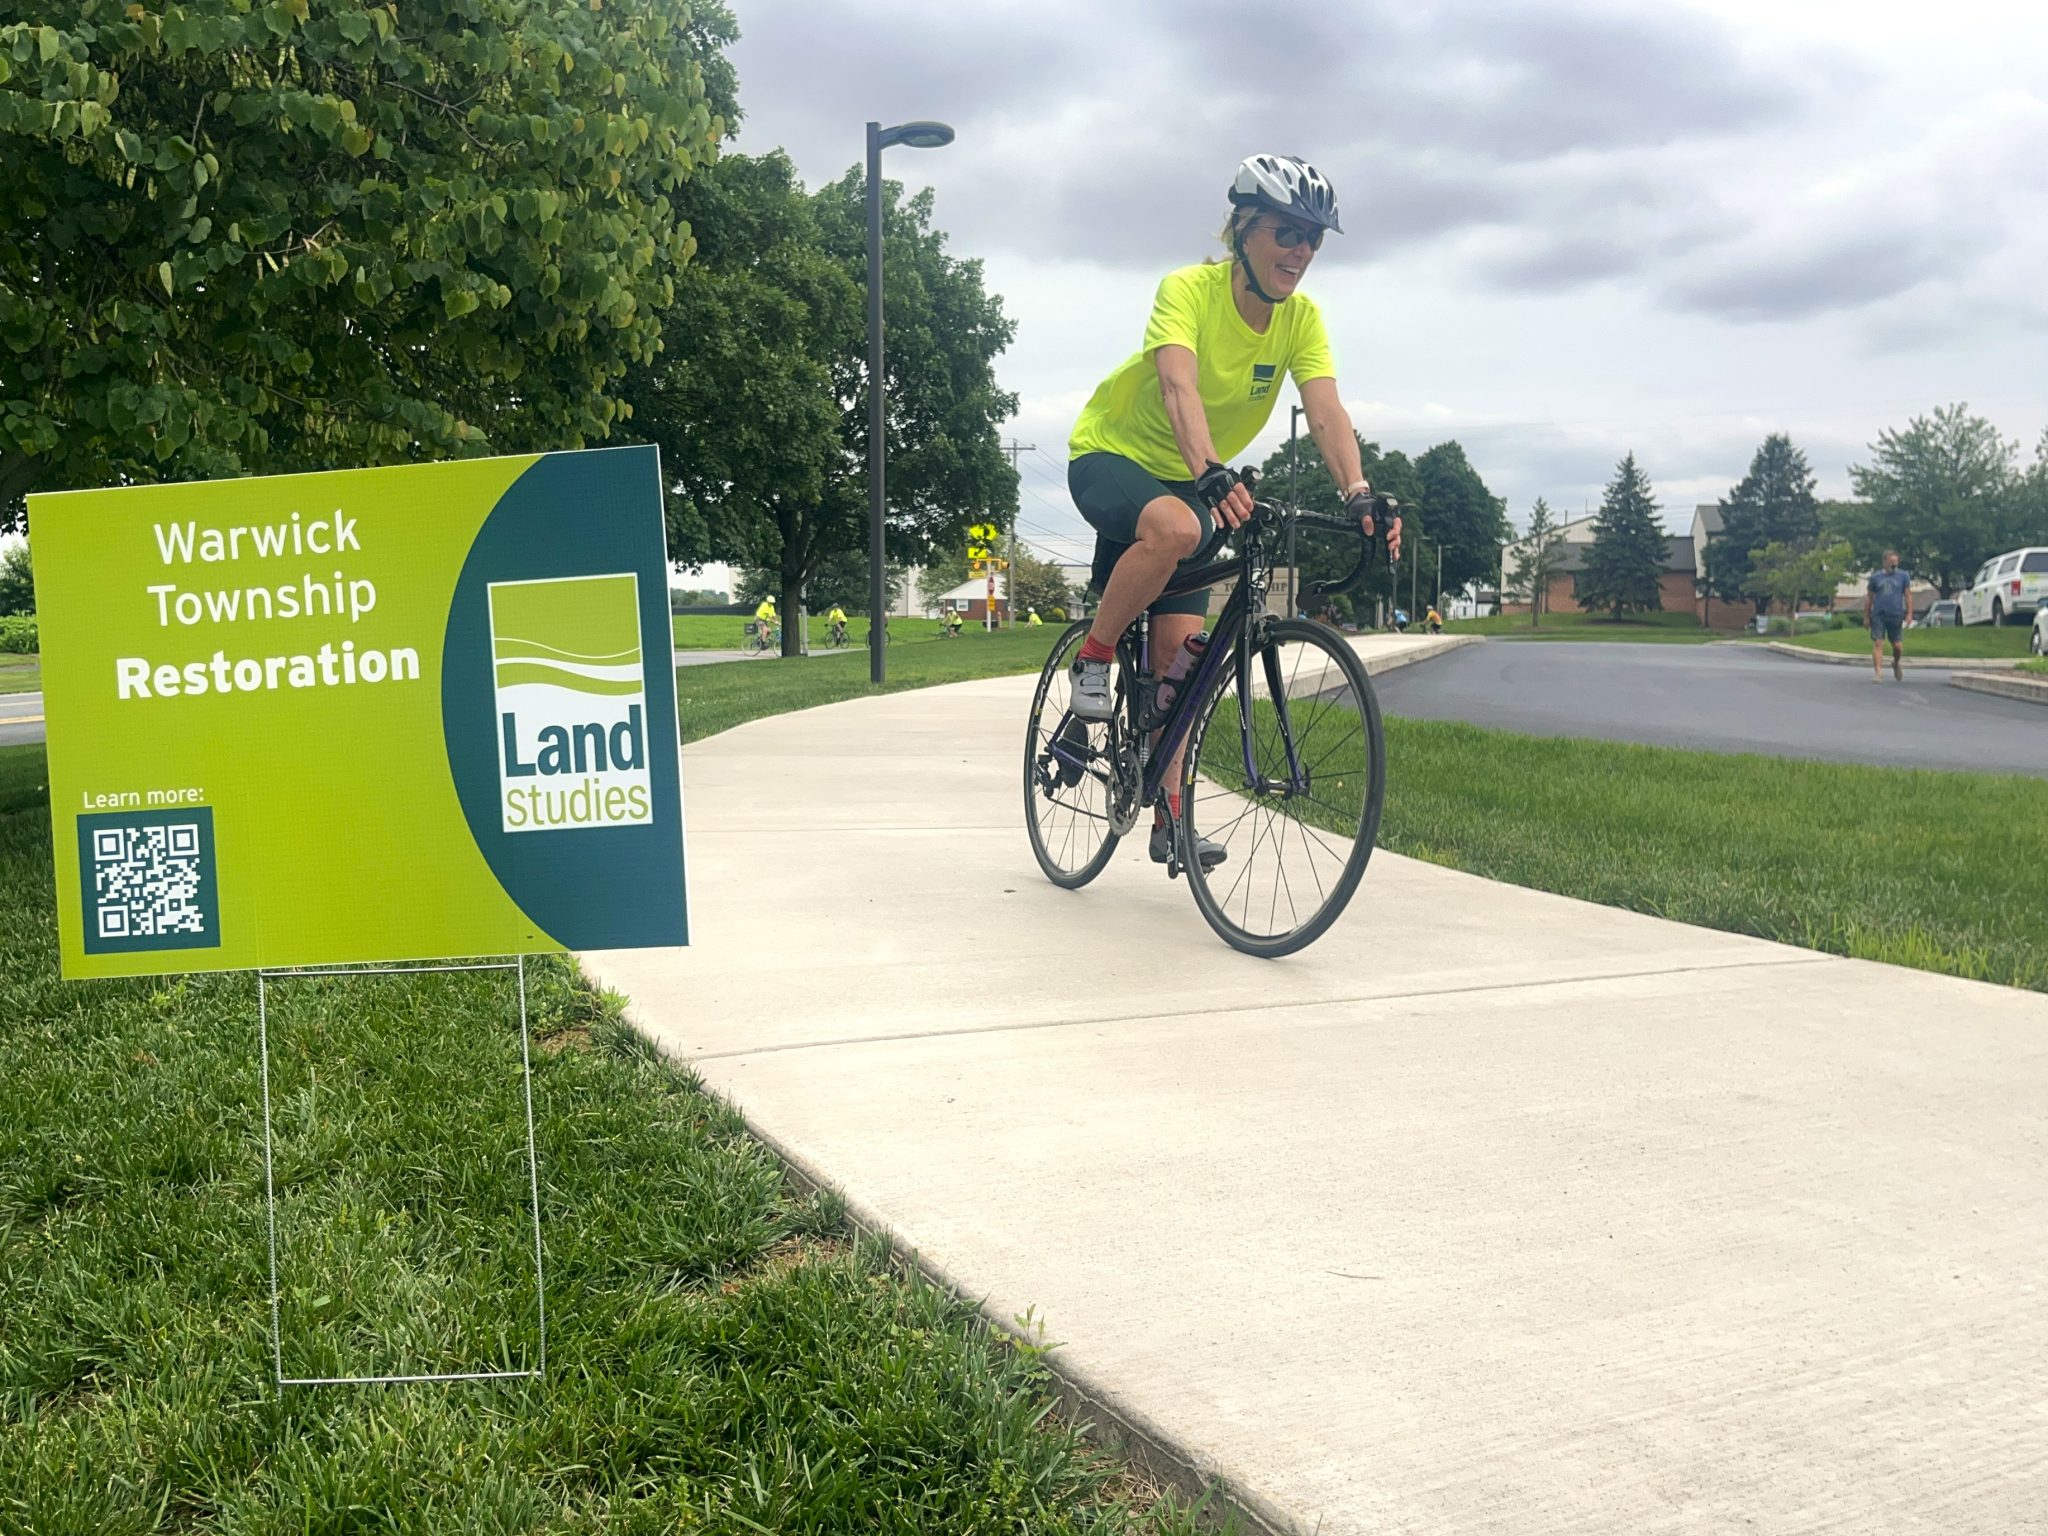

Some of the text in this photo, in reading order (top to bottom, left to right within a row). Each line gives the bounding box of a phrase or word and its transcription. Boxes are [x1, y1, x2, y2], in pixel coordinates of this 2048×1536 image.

[1249, 383, 1271, 396] Land
[153, 509, 361, 565] Warwick
[147, 570, 377, 627] Township
[116, 640, 420, 700] Restoration
[502, 704, 645, 778] Land
[83, 787, 204, 809] Learn more:
[506, 779, 649, 829] studies
